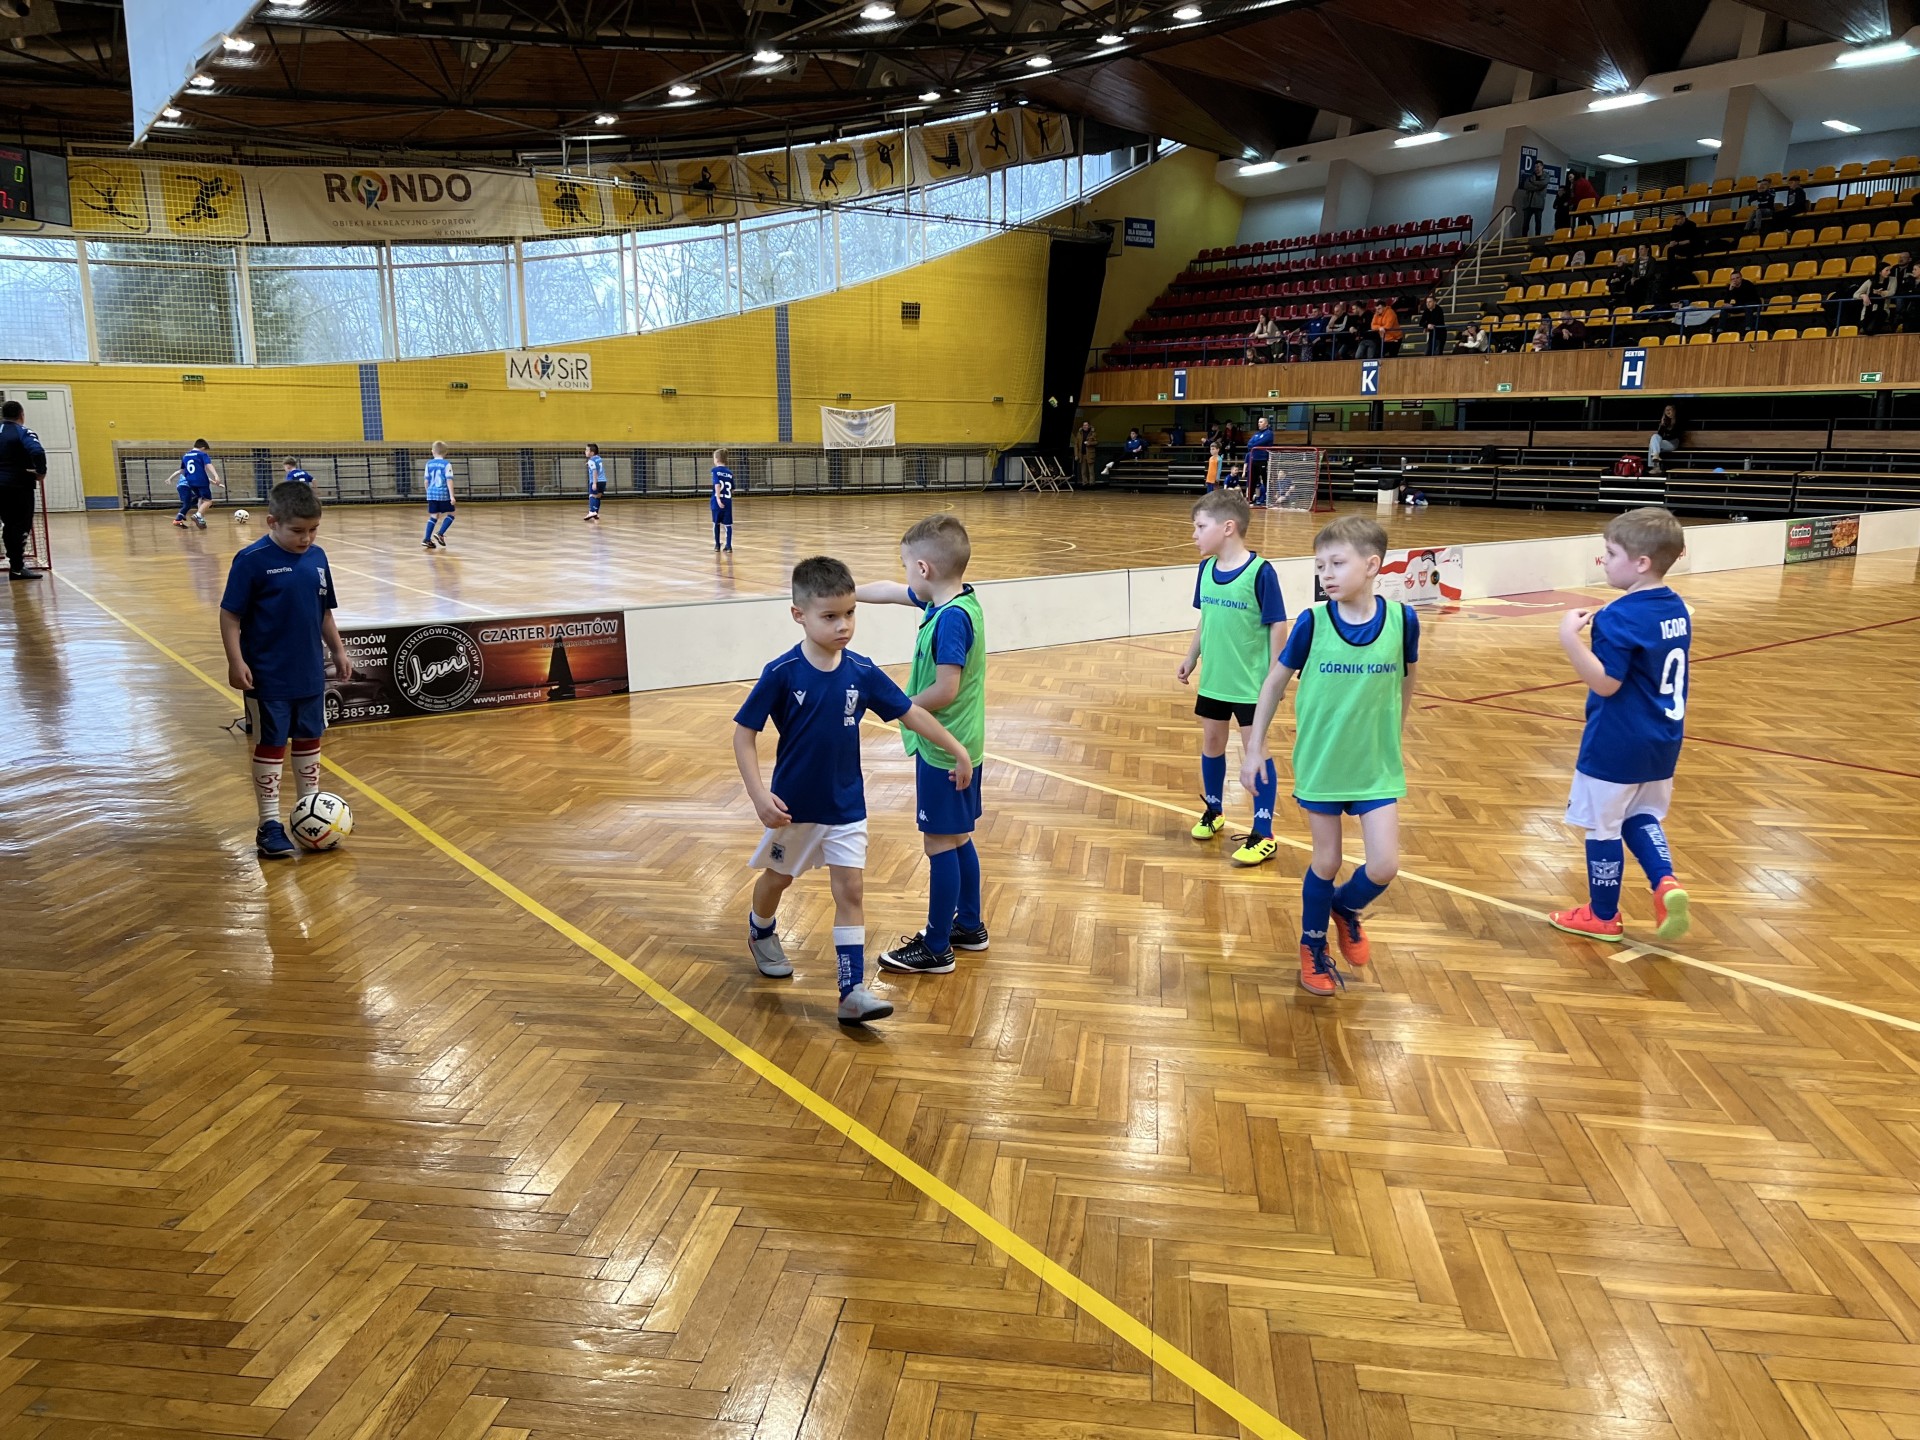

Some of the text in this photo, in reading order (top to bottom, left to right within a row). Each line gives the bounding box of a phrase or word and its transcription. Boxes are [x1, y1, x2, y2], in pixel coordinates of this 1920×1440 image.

[1524, 155, 1533, 171] D
[14, 165, 24, 183] 0
[324, 172, 472, 204] RONDO
[332, 217, 477, 228] OBIEKT REKREACYJNO-SPORTOWY
[1361, 369, 1377, 392] K
[1621, 360, 1644, 386] H
[557, 380, 590, 389] KONIN
[1174, 377, 1185, 397] L
[186, 459, 196, 474] 6
[714, 479, 732, 499] 23
[1829, 548, 1836, 556] 63
[1221, 599, 1248, 610] KONIN
[480, 617, 617, 645] CZARTER JACHTÓW
[1660, 617, 1688, 640] IGOR
[398, 649, 409, 680] ZAKŁAD
[1319, 660, 1364, 674] GÓRNIK
[1659, 647, 1686, 721] 9
[473, 690, 542, 704] www.jomi.net.pl
[343, 707, 366, 718] 385
[368, 704, 390, 715] 922
[1592, 878, 1619, 887] LPFA
